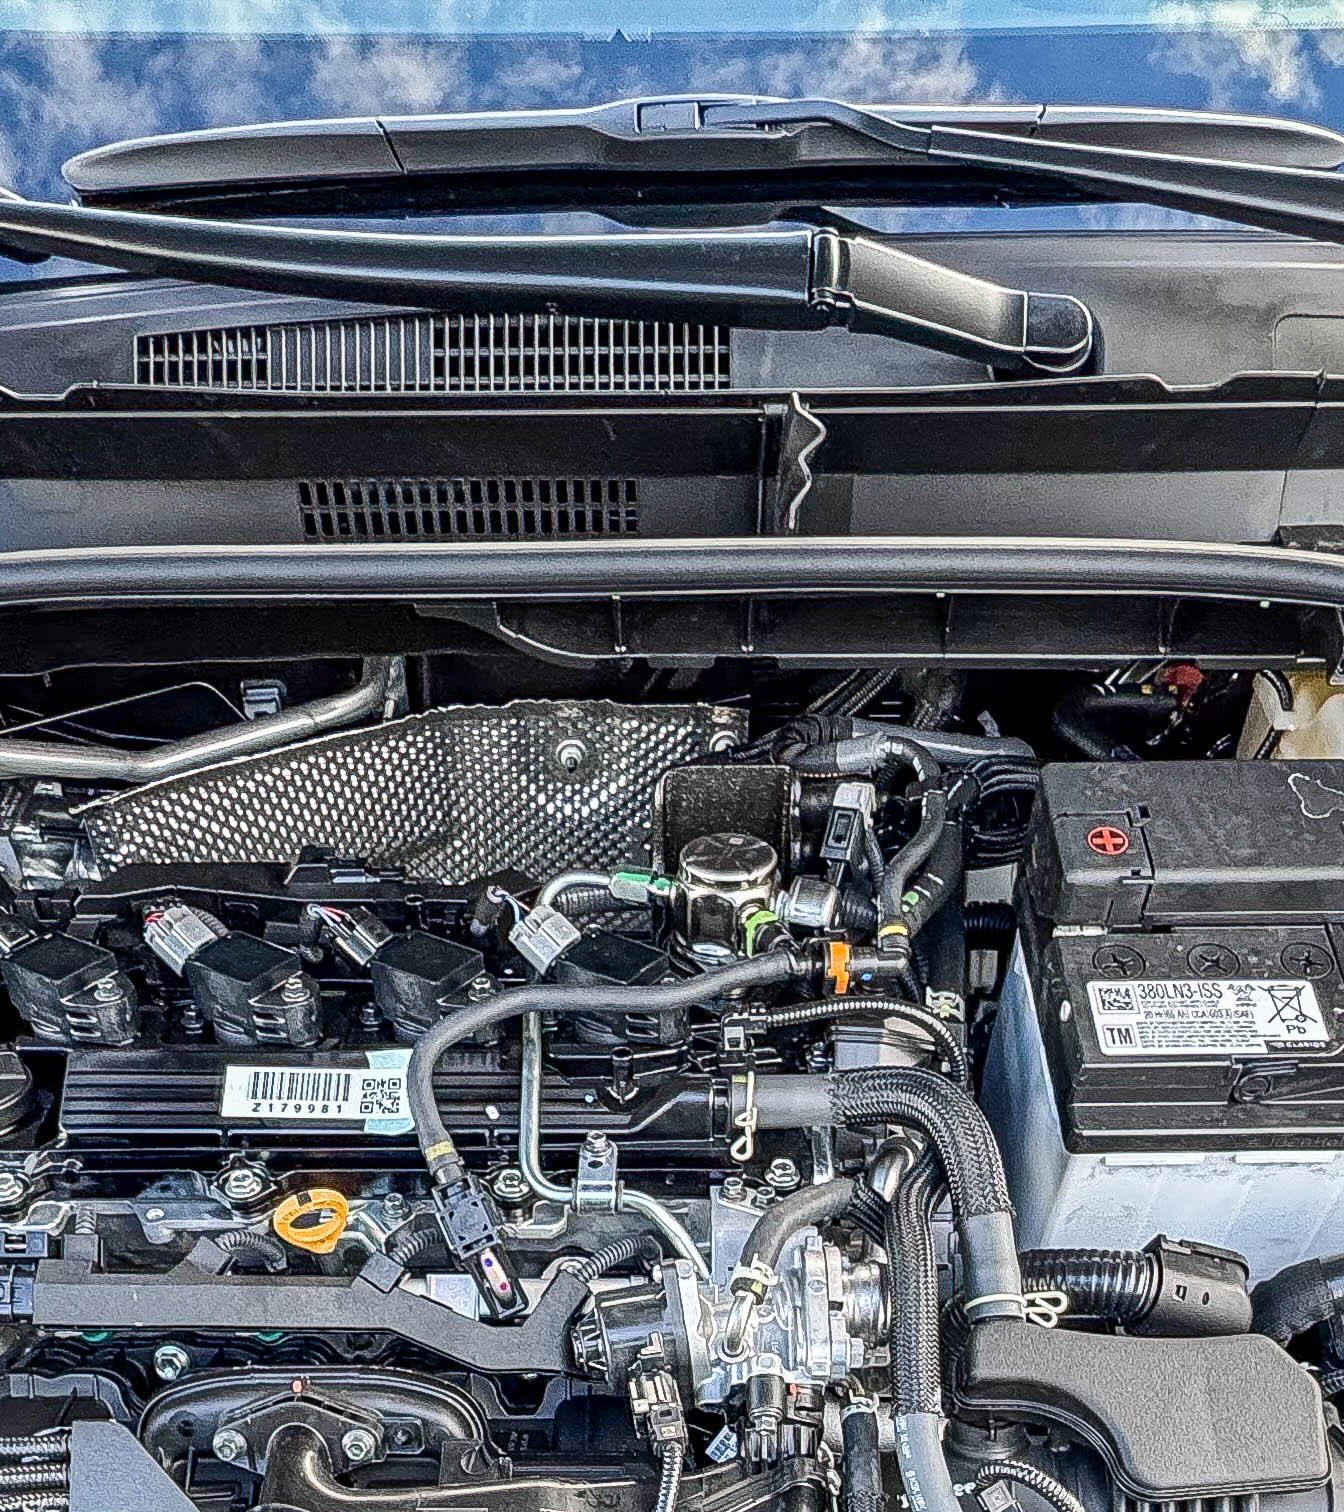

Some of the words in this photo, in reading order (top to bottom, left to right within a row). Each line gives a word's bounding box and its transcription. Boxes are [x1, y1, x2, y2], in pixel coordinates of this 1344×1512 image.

[1137, 983, 1224, 1000] 380LN3-ISS
[1106, 1027, 1134, 1046] TM
[1286, 1024, 1307, 1035] Pb
[252, 1102, 343, 1115] Z179981
